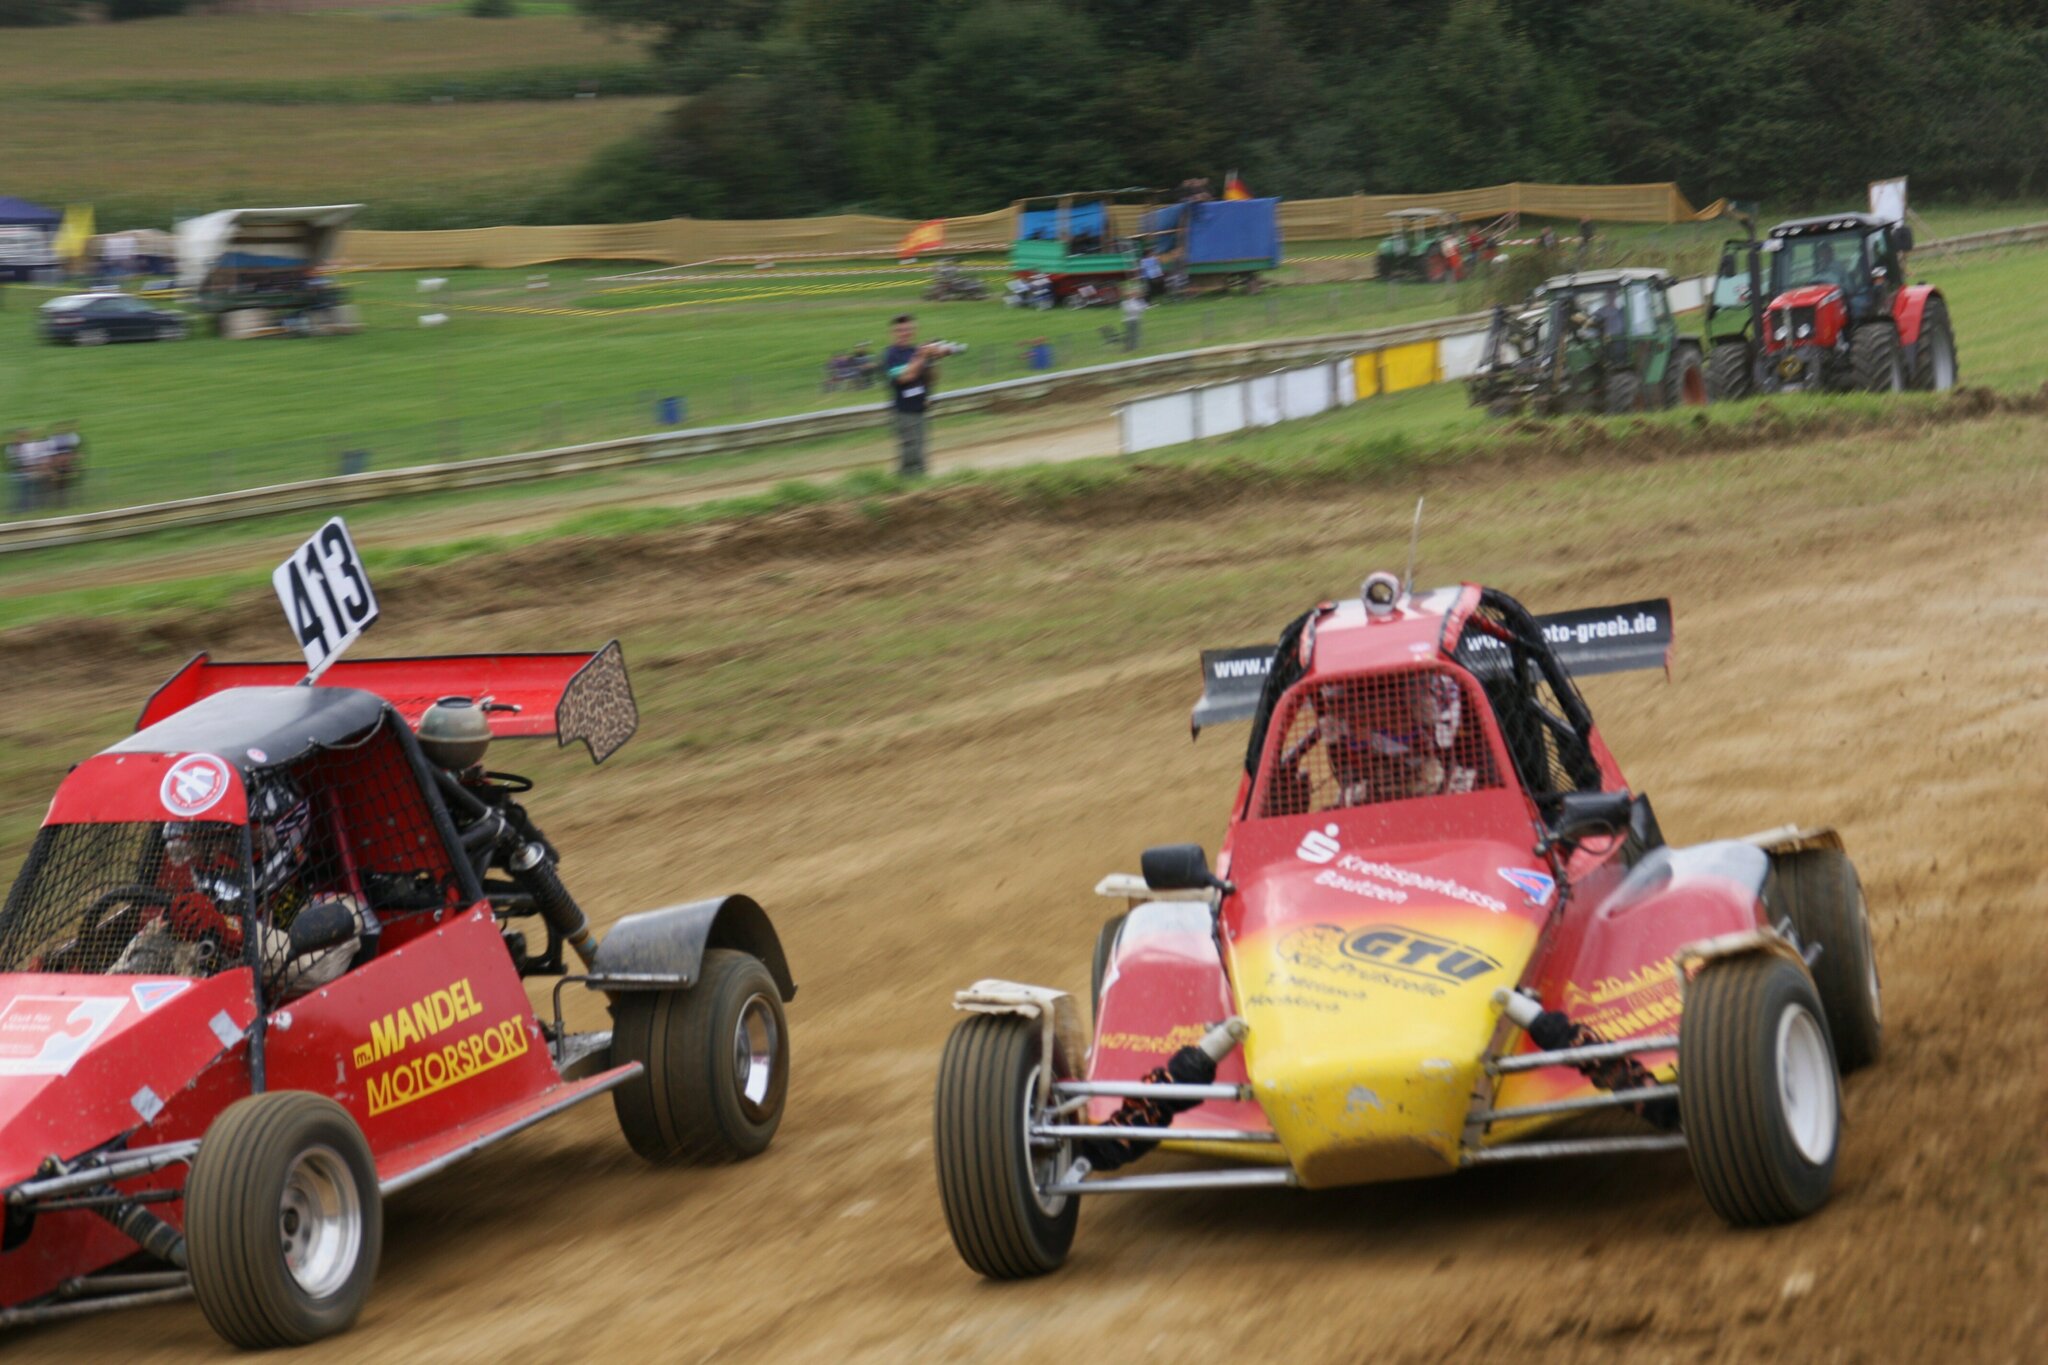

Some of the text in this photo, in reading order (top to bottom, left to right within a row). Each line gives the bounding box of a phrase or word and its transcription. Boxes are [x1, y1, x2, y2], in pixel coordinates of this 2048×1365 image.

[288, 523, 369, 657] 413
[1314, 869, 1409, 904] Bautzen
[1336, 854, 1508, 913] Kreissparkasse
[370, 978, 483, 1061] MANDEL
[367, 1014, 528, 1115] MOTORSPORT
